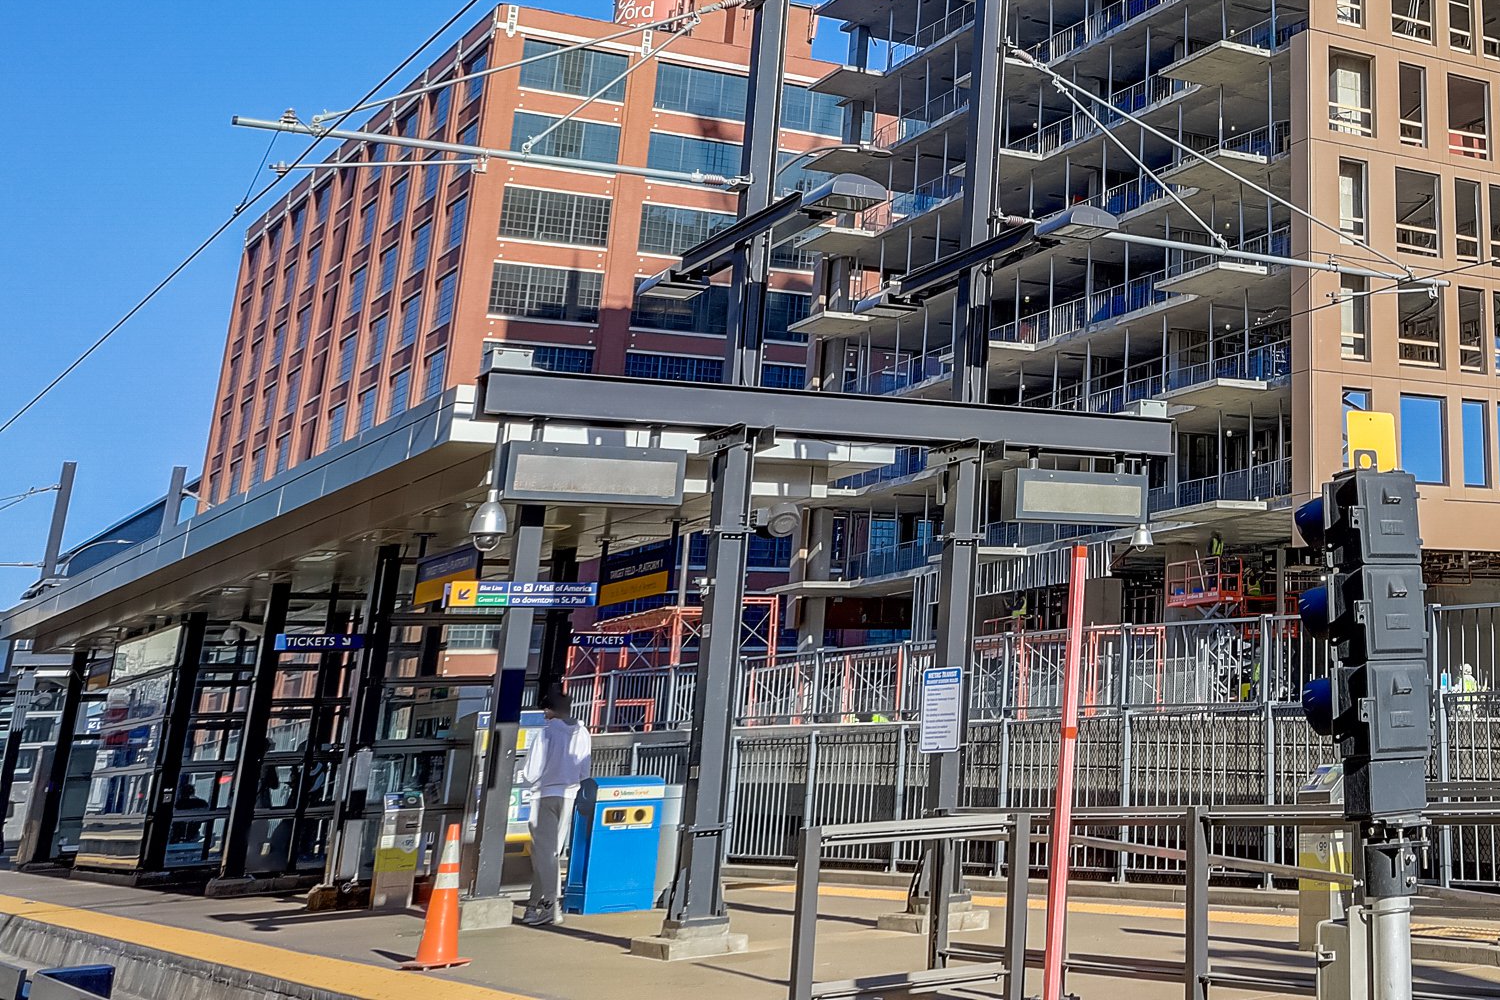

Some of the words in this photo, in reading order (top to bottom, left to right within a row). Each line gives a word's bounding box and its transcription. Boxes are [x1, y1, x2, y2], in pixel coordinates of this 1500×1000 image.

[539, 584, 554, 592] Mall
[555, 584, 563, 592] of
[563, 584, 592, 592] America
[521, 596, 560, 604] downtown
[570, 596, 586, 604] Paul
[286, 637, 335, 647] TICKETS
[586, 636, 625, 645] TICKETS
